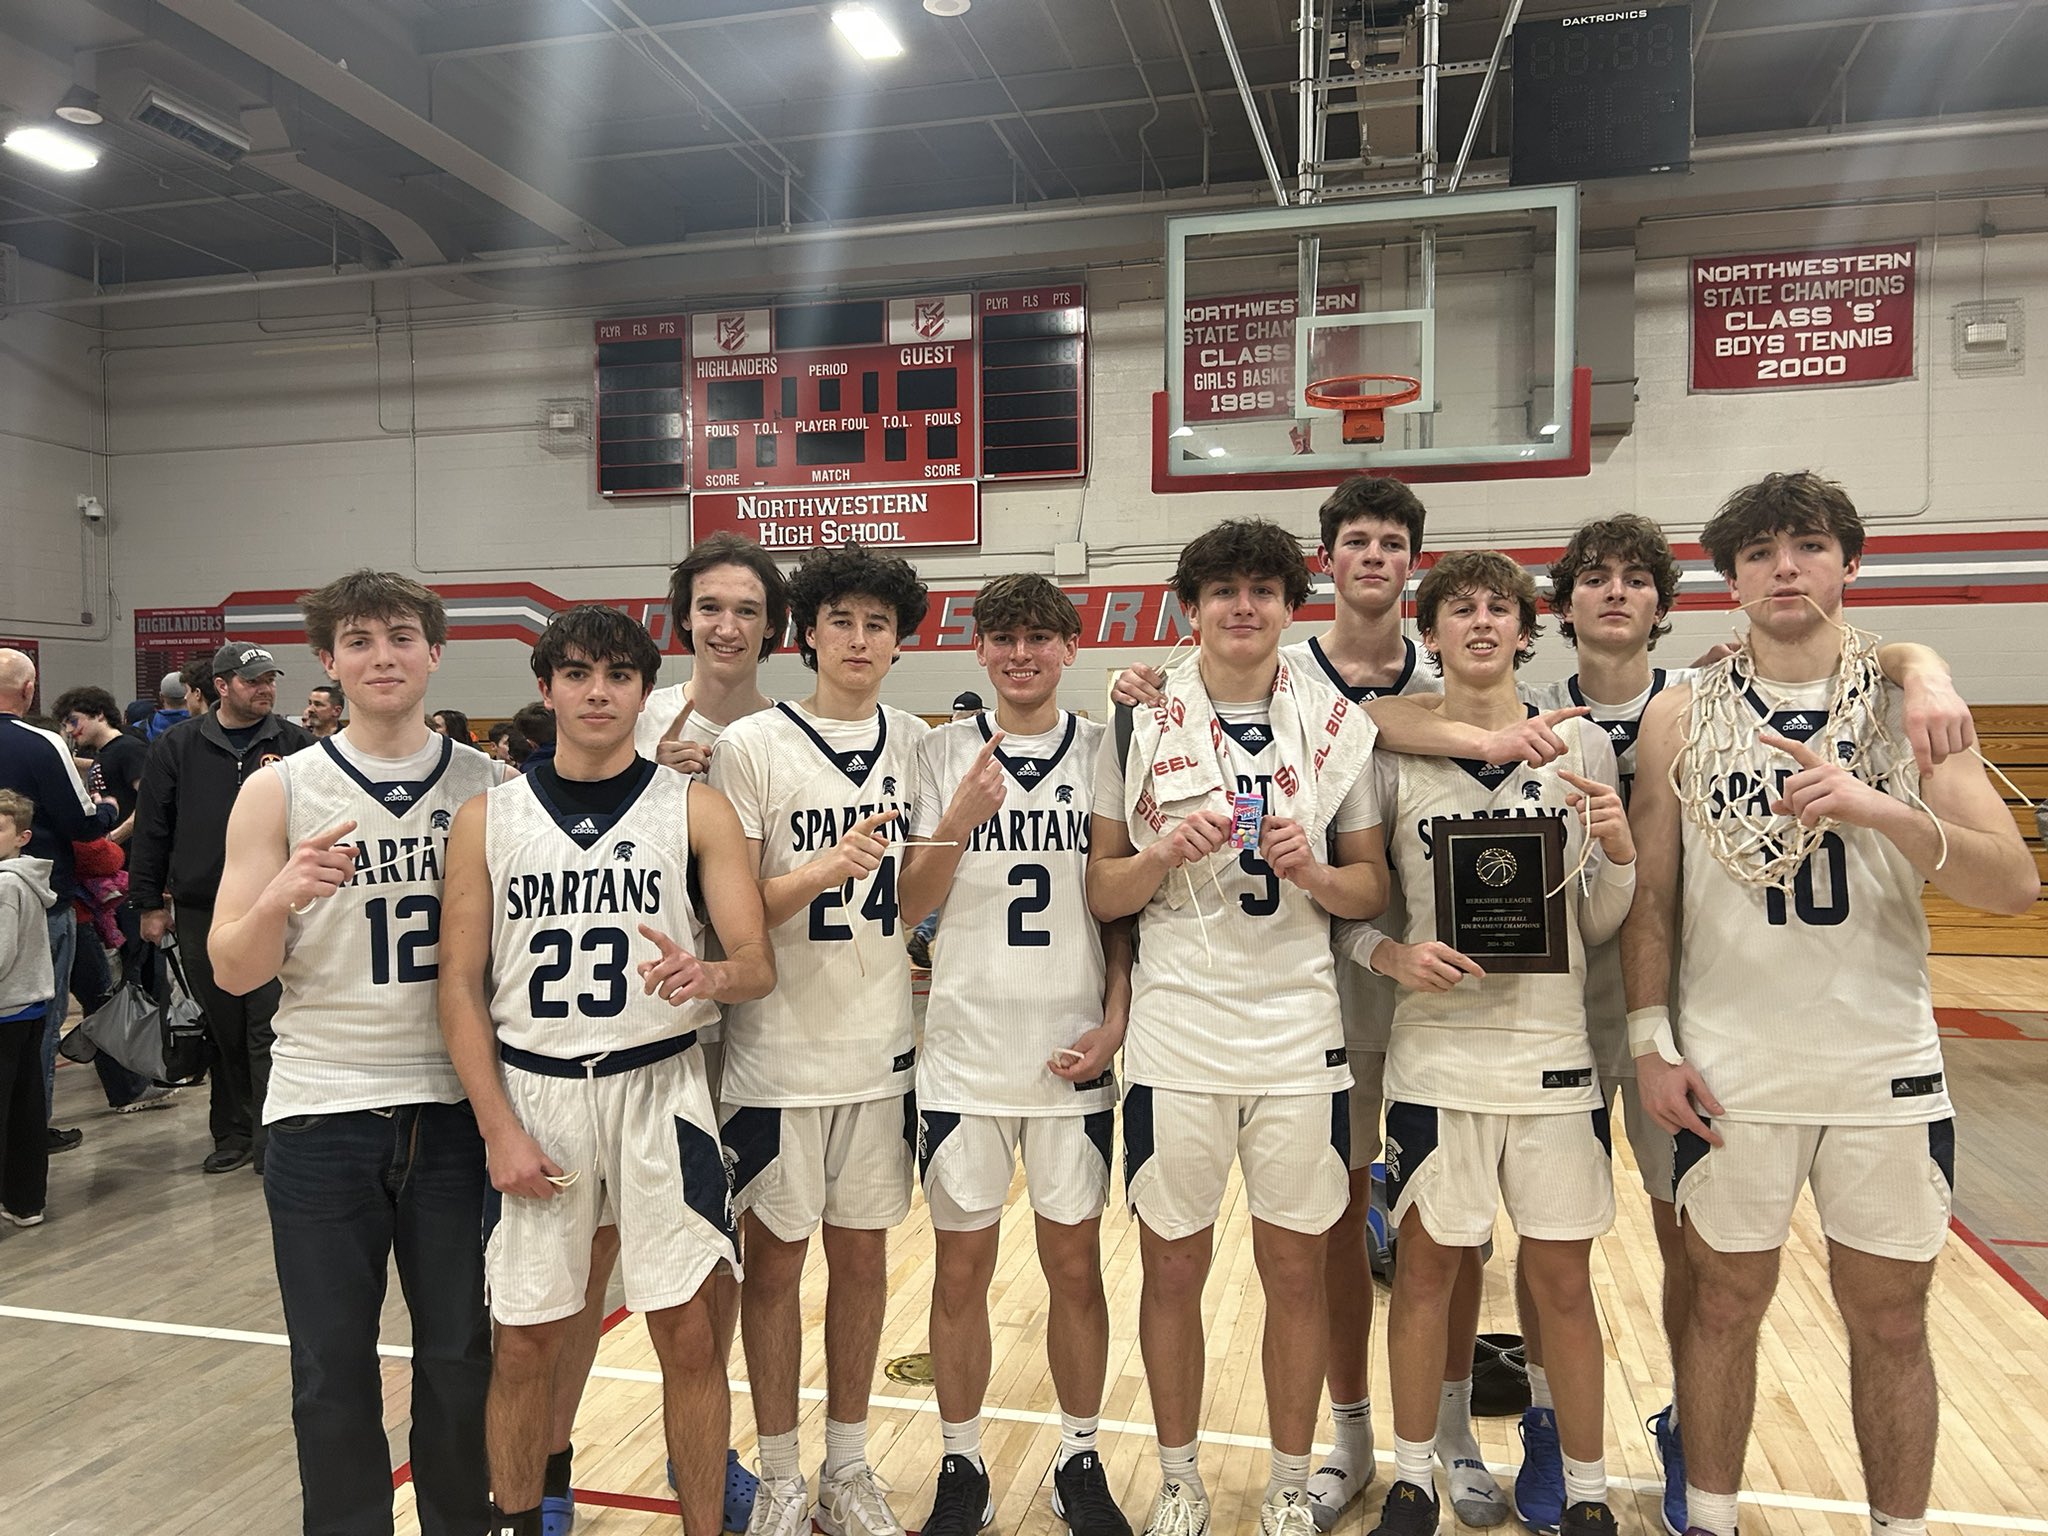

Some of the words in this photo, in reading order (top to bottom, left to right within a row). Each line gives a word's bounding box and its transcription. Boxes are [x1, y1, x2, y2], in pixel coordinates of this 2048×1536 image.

[1562, 9, 1648, 27] DAKTRONICS
[1697, 251, 1912, 284] NORTHWESTERN
[1703, 284, 1773, 308] STATE
[1780, 275, 1906, 303] CHAMPIONS
[985, 296, 1010, 310] PLYR
[1022, 294, 1040, 307] FLS
[1052, 292, 1072, 305] PTS
[1184, 292, 1357, 322] NORTHWESERN
[1725, 306, 1833, 332] CLASS
[600, 326, 622, 338] PLYR
[632, 323, 648, 336] FLS
[658, 321, 676, 334] PTS
[1184, 325, 1239, 345] STATE
[1715, 334, 1786, 357] BOYS
[1795, 326, 1894, 352] TENNIS
[900, 345, 956, 366] GUEST
[1200, 344, 1292, 368] CLASS
[696, 357, 778, 377] HIGHLANDERS
[808, 362, 849, 377] PERIOD
[1757, 355, 1847, 380] 2000
[1194, 371, 1237, 391] GIRLS
[795, 418, 838, 433] PLAYER
[840, 416, 870, 431] FOUL
[924, 412, 962, 427] FOULS
[705, 423, 740, 438] FOULS
[811, 468, 852, 483] MATCH
[924, 463, 962, 478] SCORE
[705, 473, 741, 487] SCORE
[736, 492, 929, 520] NORTHWESTERN
[758, 522, 814, 546] HIGH
[820, 519, 906, 544] SCHOOL
[138, 616, 222, 632] HIGHLANDERS
[1782, 722, 1814, 731] adidas
[1240, 733, 1267, 742] adidas
[845, 763, 868, 773] adidas
[1016, 768, 1041, 778] adidas
[1477, 767, 1505, 777] adidas
[384, 792, 413, 802] adidas
[570, 826, 599, 836] adidas
[1760, 831, 1850, 925] 10
[507, 867, 662, 920] SPARTANS
[808, 856, 899, 941] 24
[1504, 896, 1533, 904] LEAGUE
[1007, 863, 1051, 947] 2
[1460, 922, 1502, 930] TOURNAMENT
[365, 894, 442, 985] 12
[528, 926, 630, 1018] 23
